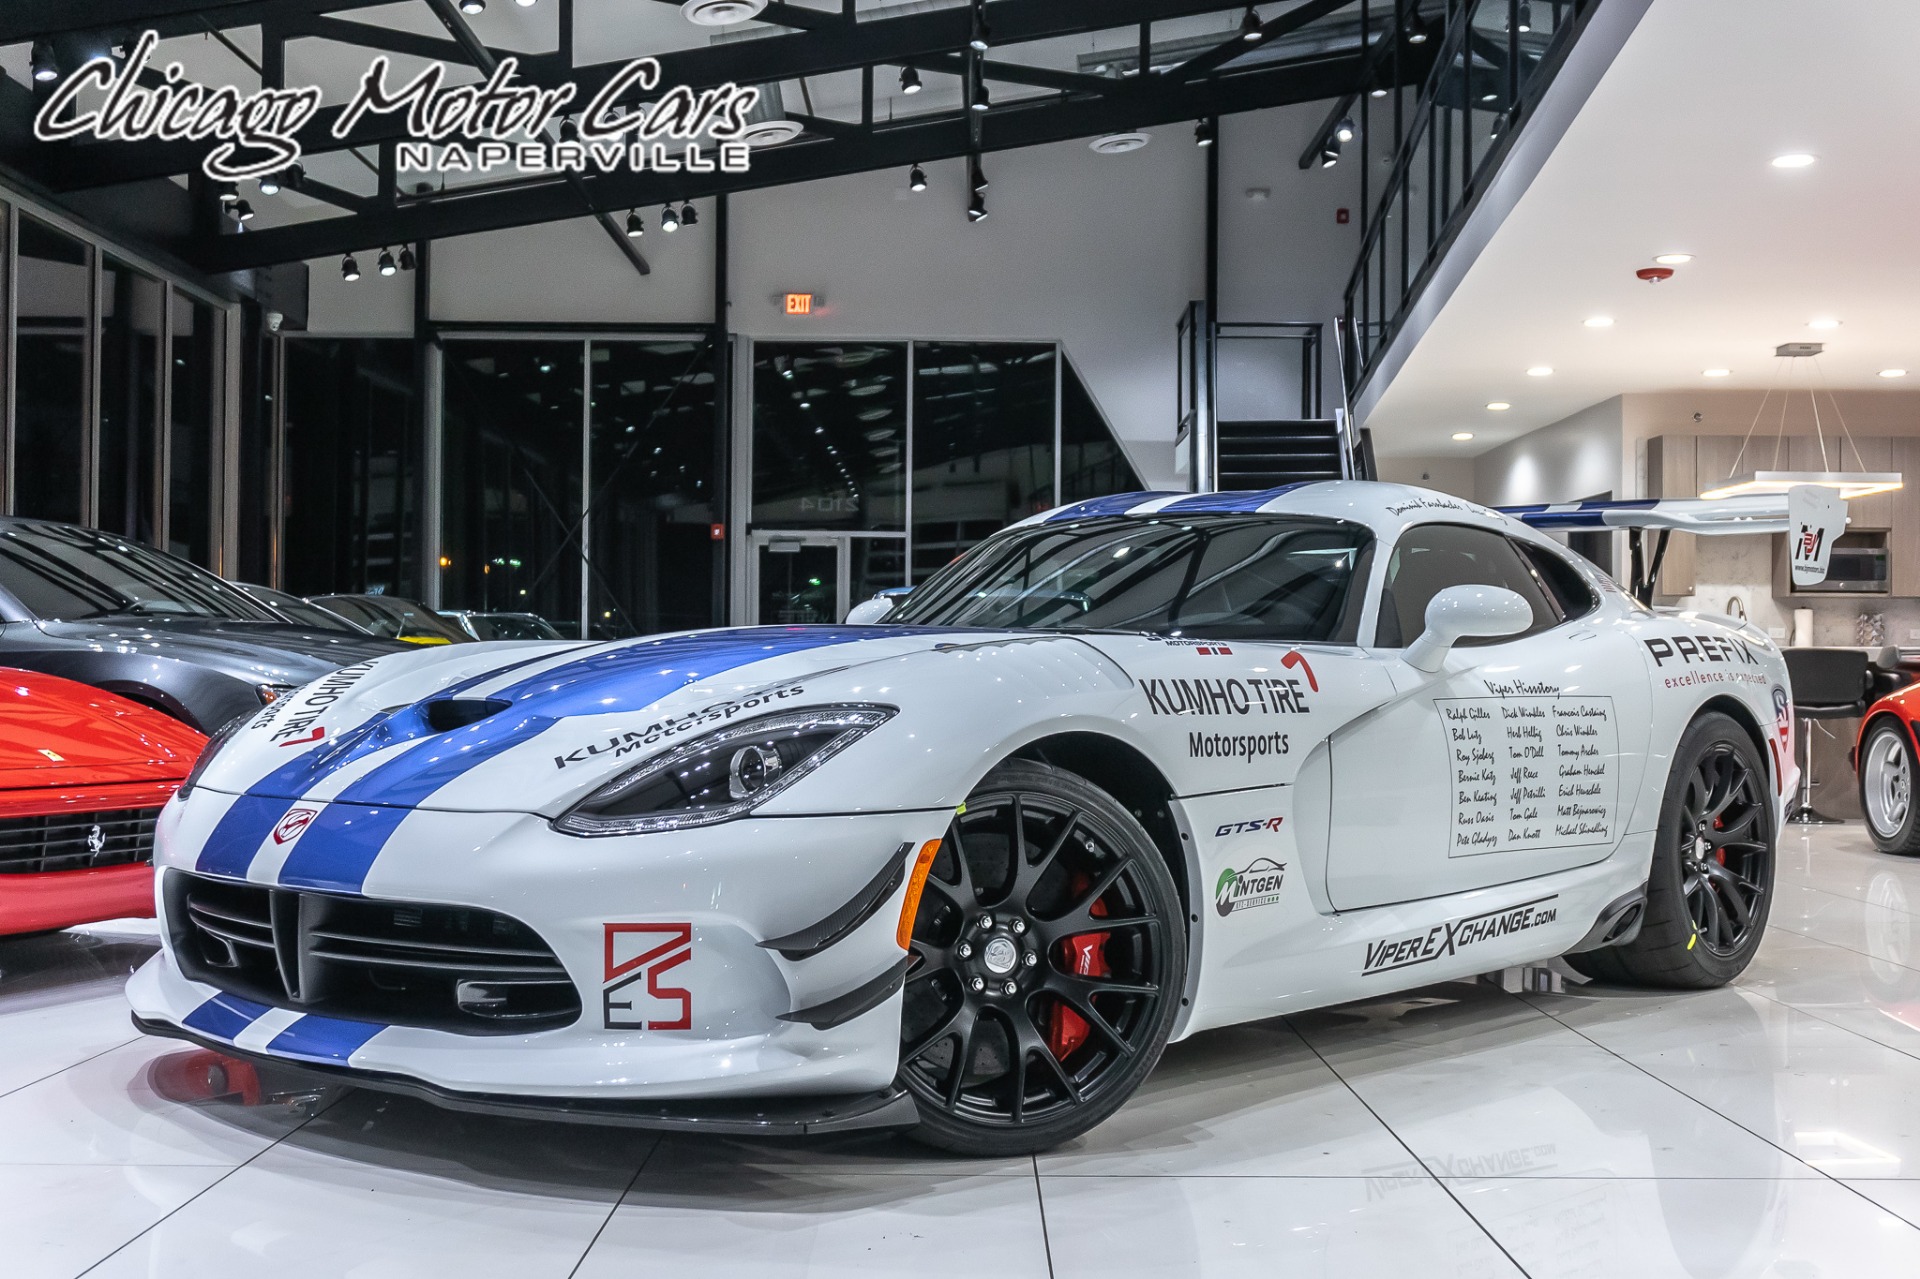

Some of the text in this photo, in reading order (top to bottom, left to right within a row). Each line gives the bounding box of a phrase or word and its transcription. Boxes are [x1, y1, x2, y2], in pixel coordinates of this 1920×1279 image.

[786, 294, 812, 313] EXIT
[1644, 635, 1759, 668] PREFIX
[1664, 670, 1724, 689] excellence
[1483, 679, 1514, 699] Viper
[1446, 707, 1490, 723] Ralph Gilles
[1501, 706, 1519, 719] Dick
[615, 685, 805, 758] Motorsports
[1452, 727, 1482, 745] Bob Lutz
[1189, 731, 1289, 763] Motorsports
[1508, 746, 1523, 758] Tom
[1557, 744, 1579, 761] Tommy
[1456, 749, 1470, 766] Roy
[1510, 767, 1522, 784] Jeff
[1458, 789, 1497, 807] Ben Keating
[1510, 787, 1522, 805] Jeff
[1458, 812, 1474, 825] Russ
[1510, 808, 1522, 820] Tom
[1557, 804, 1572, 817] Matt
[1215, 817, 1283, 837] GTS-R
[1508, 828, 1522, 842] Dan
